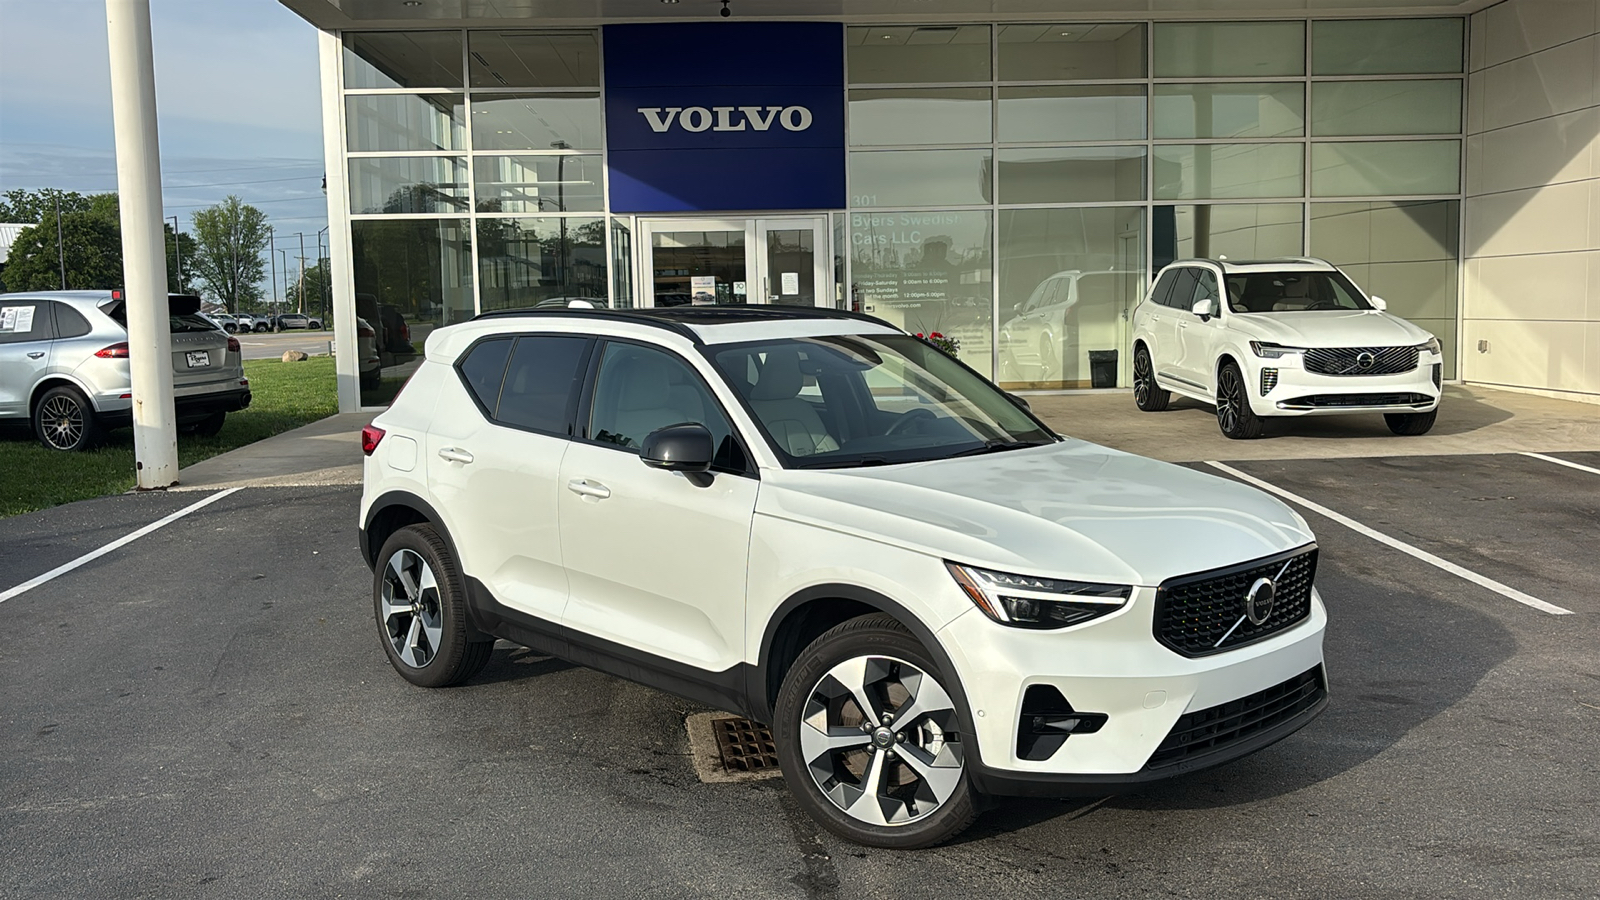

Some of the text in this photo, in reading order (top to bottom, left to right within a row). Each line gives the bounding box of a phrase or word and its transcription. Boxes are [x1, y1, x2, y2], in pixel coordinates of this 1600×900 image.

[637, 105, 813, 132] VOLVO
[852, 195, 877, 206] 301
[852, 214, 895, 230] Byers
[852, 230, 921, 245] Cars LLC
[782, 668, 808, 723] MICHELIN
